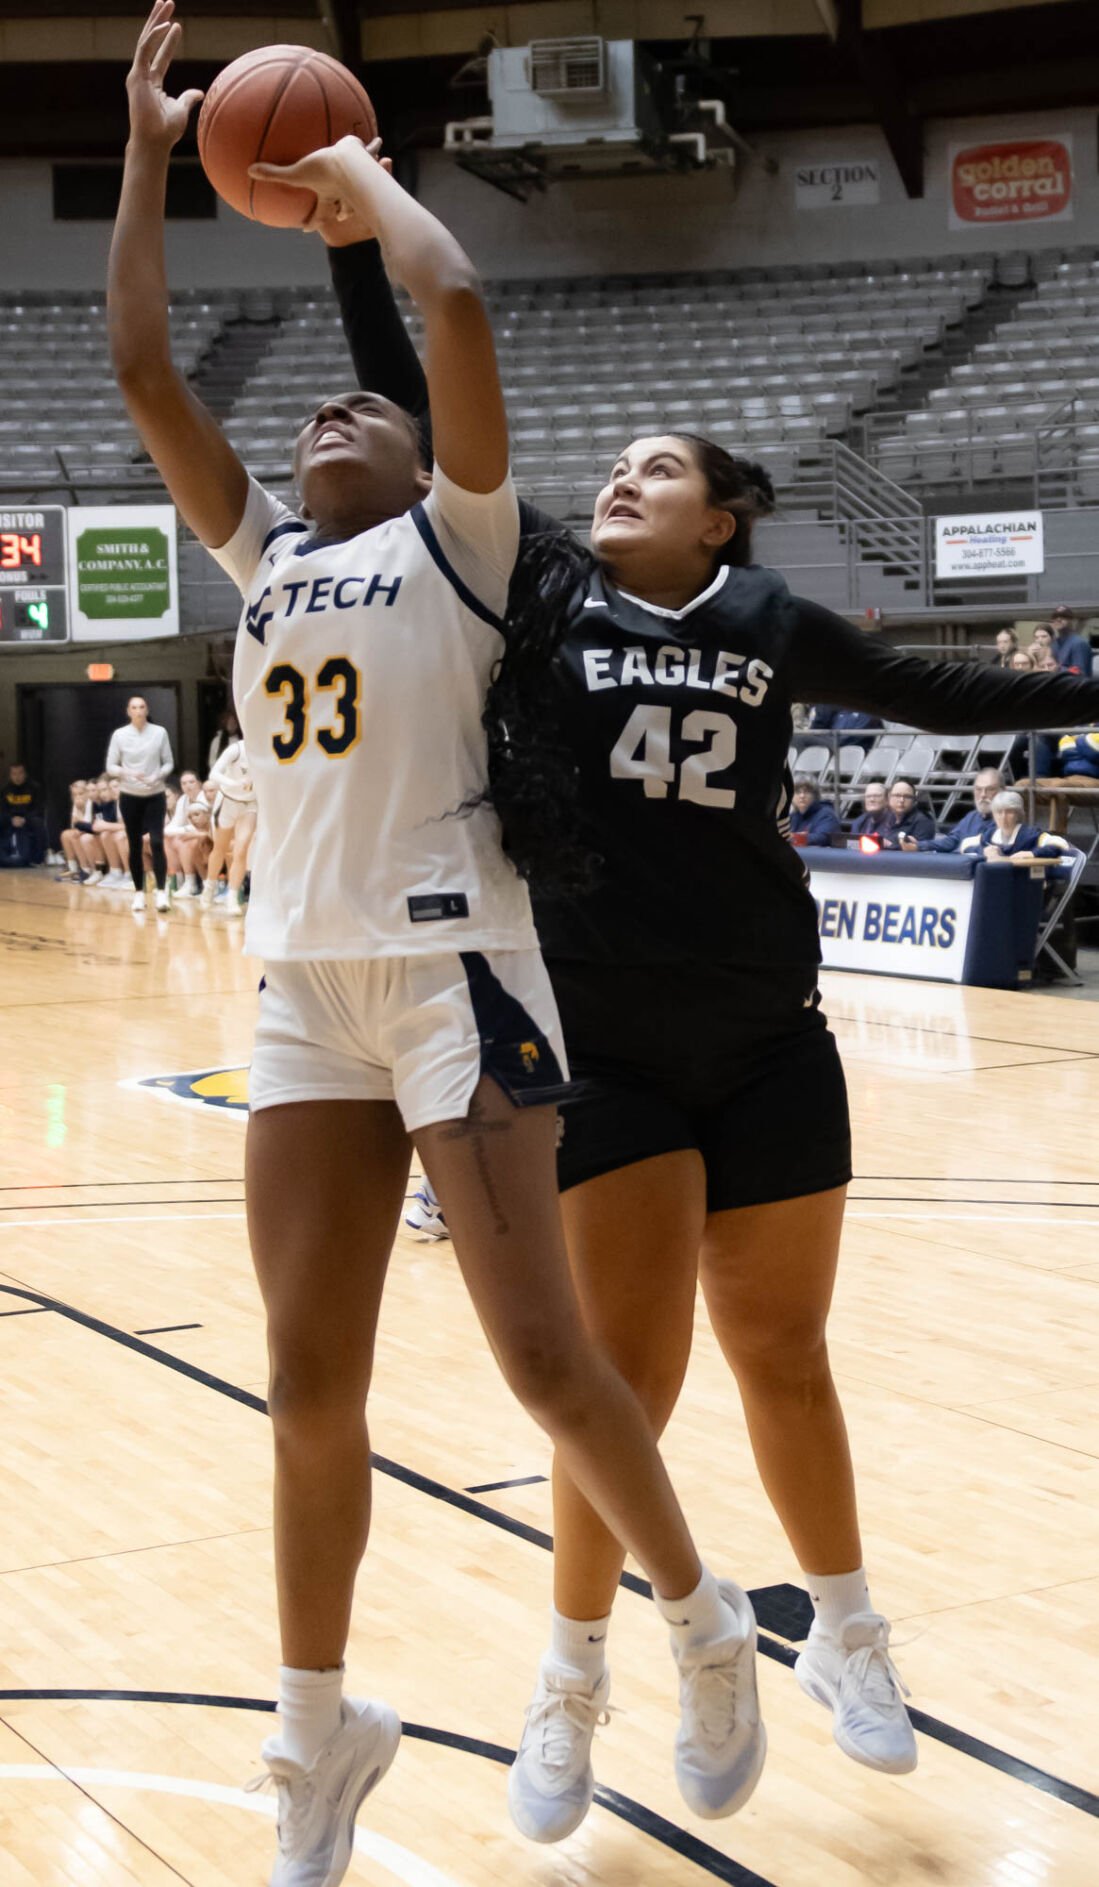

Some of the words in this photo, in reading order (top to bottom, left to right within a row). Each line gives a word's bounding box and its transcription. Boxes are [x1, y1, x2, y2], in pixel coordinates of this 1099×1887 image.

[797, 164, 878, 186] SECTION
[958, 155, 1056, 186] golden
[831, 185, 843, 201] 2
[974, 173, 1065, 201] corral
[942, 522, 1037, 537] APPALACHIAN
[0, 534, 42, 568] 34
[96, 543, 139, 554] SMITH
[139, 543, 150, 554] &
[282, 573, 403, 617] TECH
[28, 602, 49, 629] 4
[582, 645, 774, 707] EAGLES
[265, 653, 362, 765] 33
[609, 703, 737, 809] 42
[862, 902, 957, 949] BEARS
